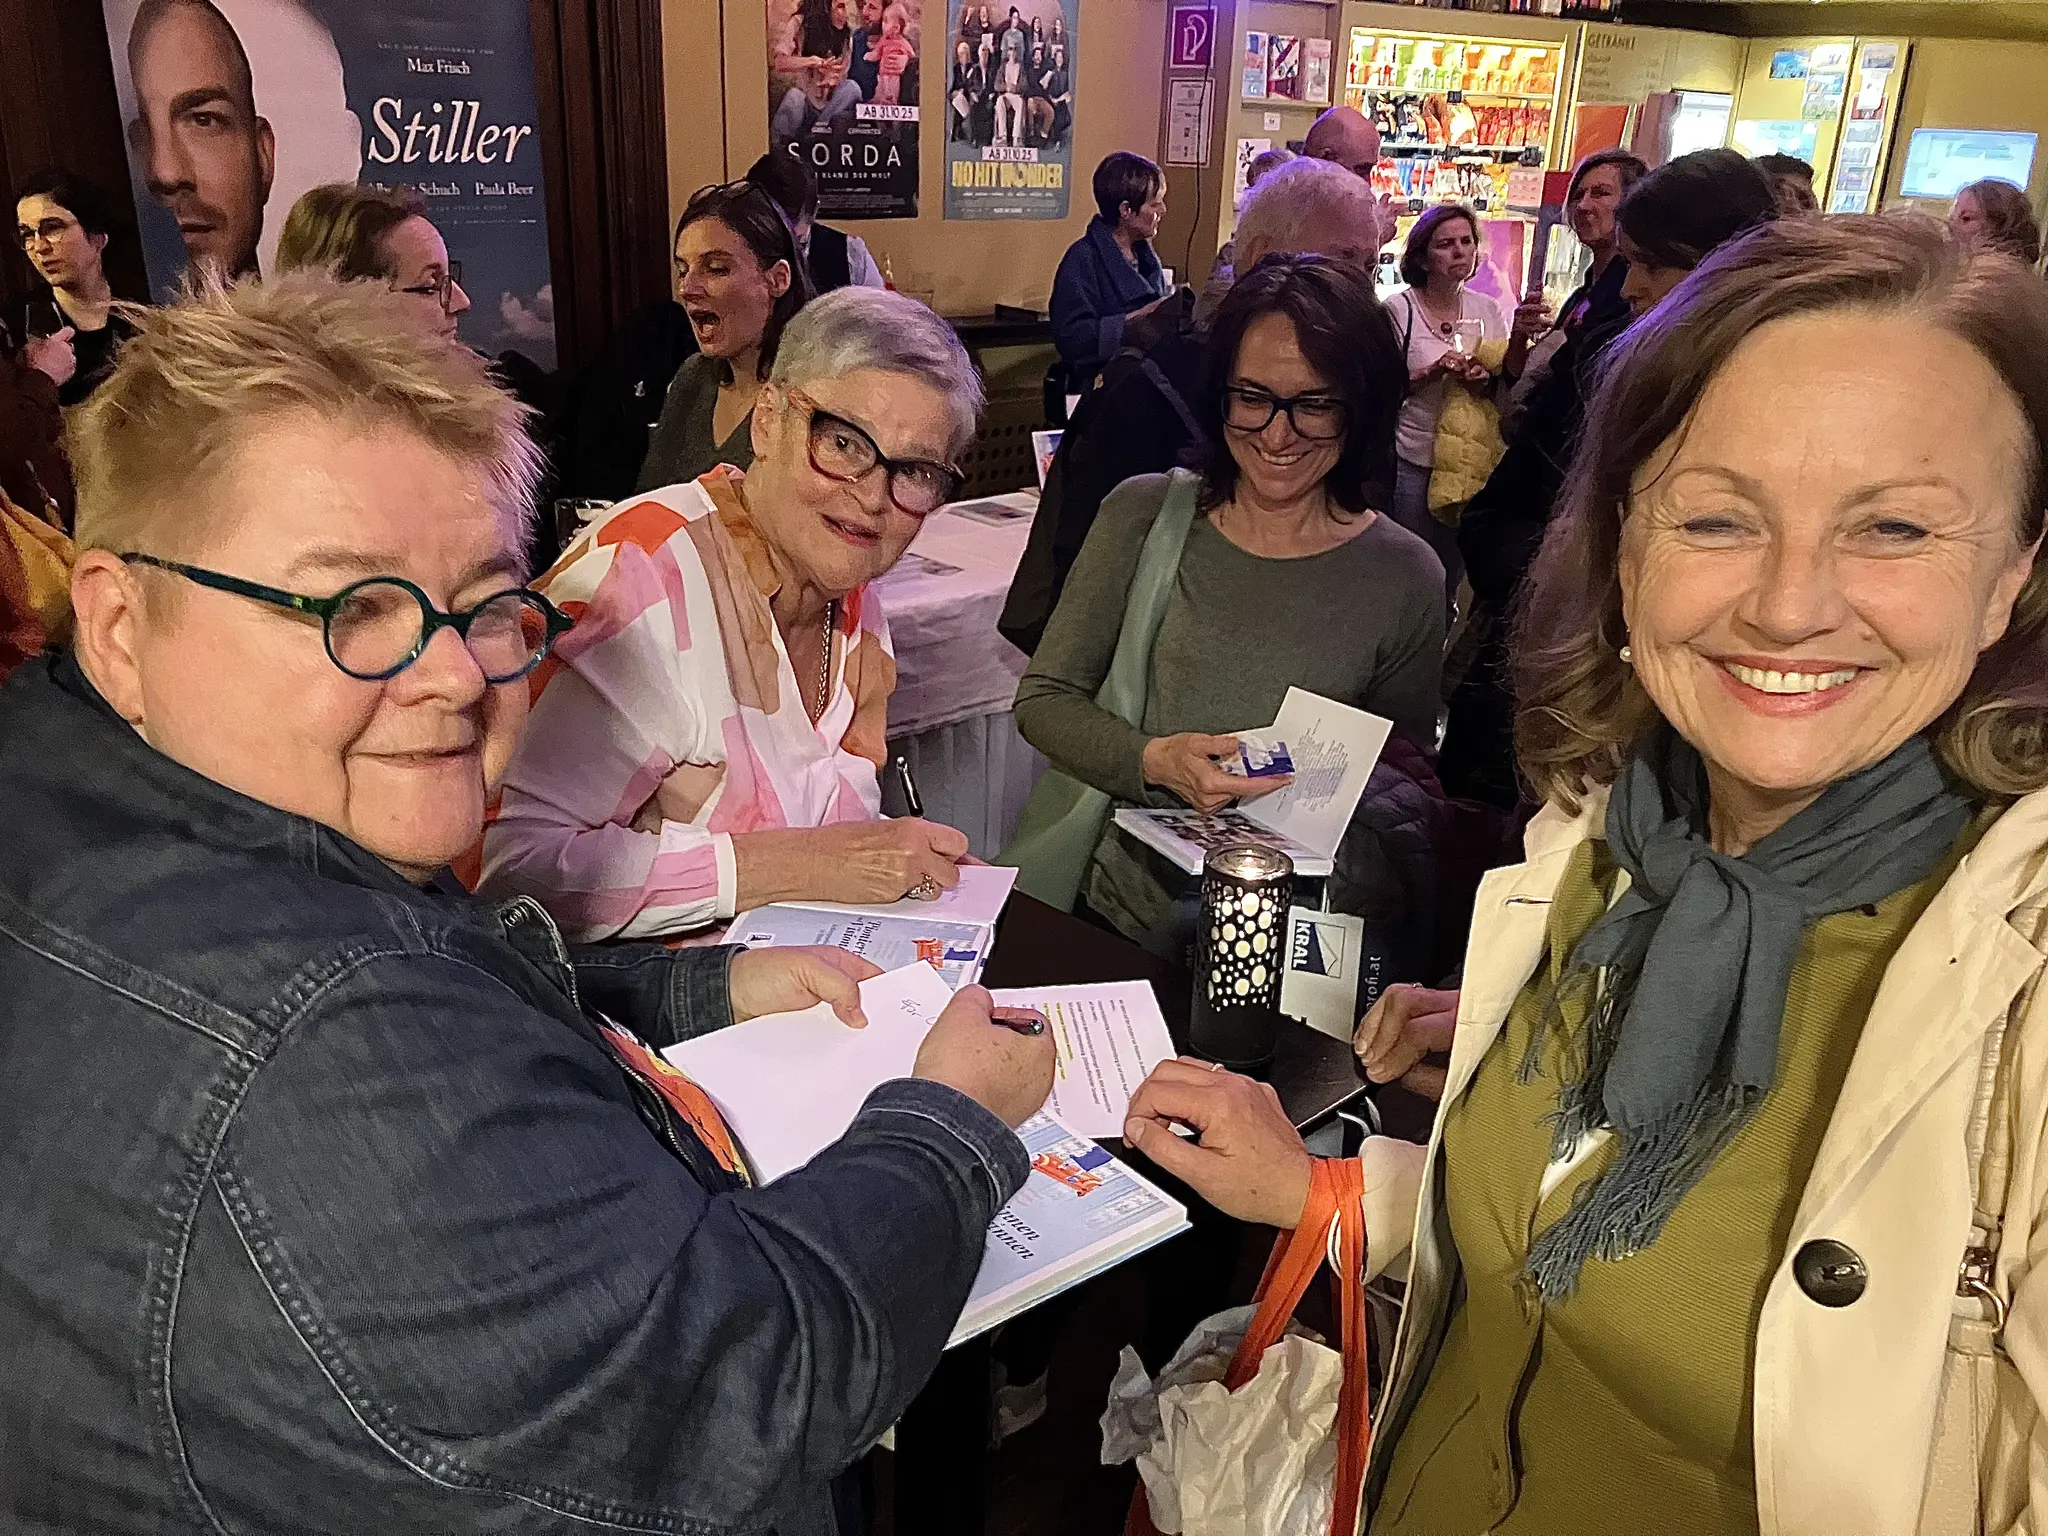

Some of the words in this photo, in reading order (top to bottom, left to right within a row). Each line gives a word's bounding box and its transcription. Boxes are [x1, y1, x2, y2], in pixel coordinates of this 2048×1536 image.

[407, 57, 434, 73] Max
[437, 59, 472, 75] Frisch
[863, 105, 877, 118] AB
[367, 97, 532, 164] Stiller
[788, 142, 901, 166] SORDA
[952, 160, 974, 187] NO
[974, 161, 1000, 187] HIT
[1000, 162, 1063, 188] WONDER
[418, 181, 461, 196] Schuch
[475, 181, 505, 196] Paula
[508, 182, 534, 196] Beer
[838, 922, 864, 949] Vision
[852, 920, 882, 955] Pionieri
[1293, 922, 1311, 968] KRAL
